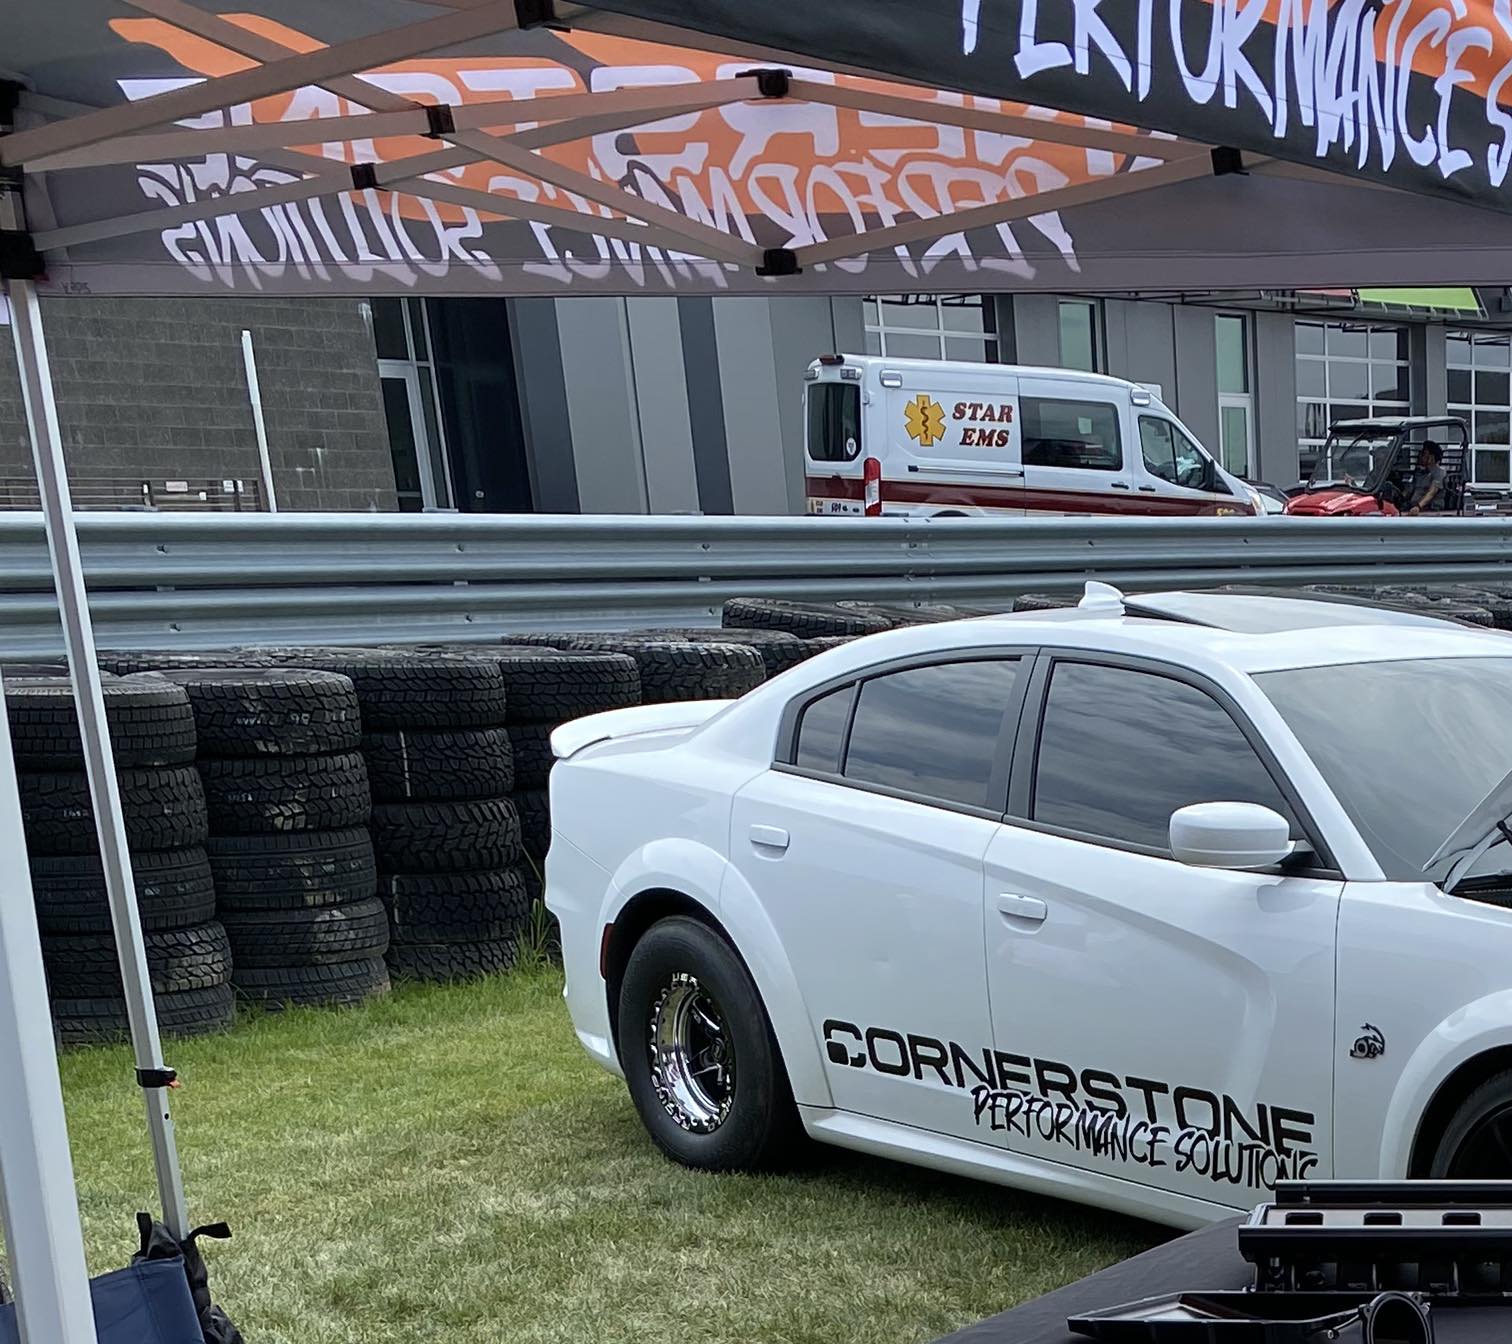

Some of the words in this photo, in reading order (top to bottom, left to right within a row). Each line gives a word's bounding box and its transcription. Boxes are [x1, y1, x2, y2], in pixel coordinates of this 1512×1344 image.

[952, 401, 1014, 423] STAR
[959, 427, 1010, 448] EMS
[822, 1018, 1316, 1157] CORNERSTONE
[969, 1084, 1173, 1170] PERFORMANCE
[1173, 1129, 1319, 1191] SOLUTIONS
